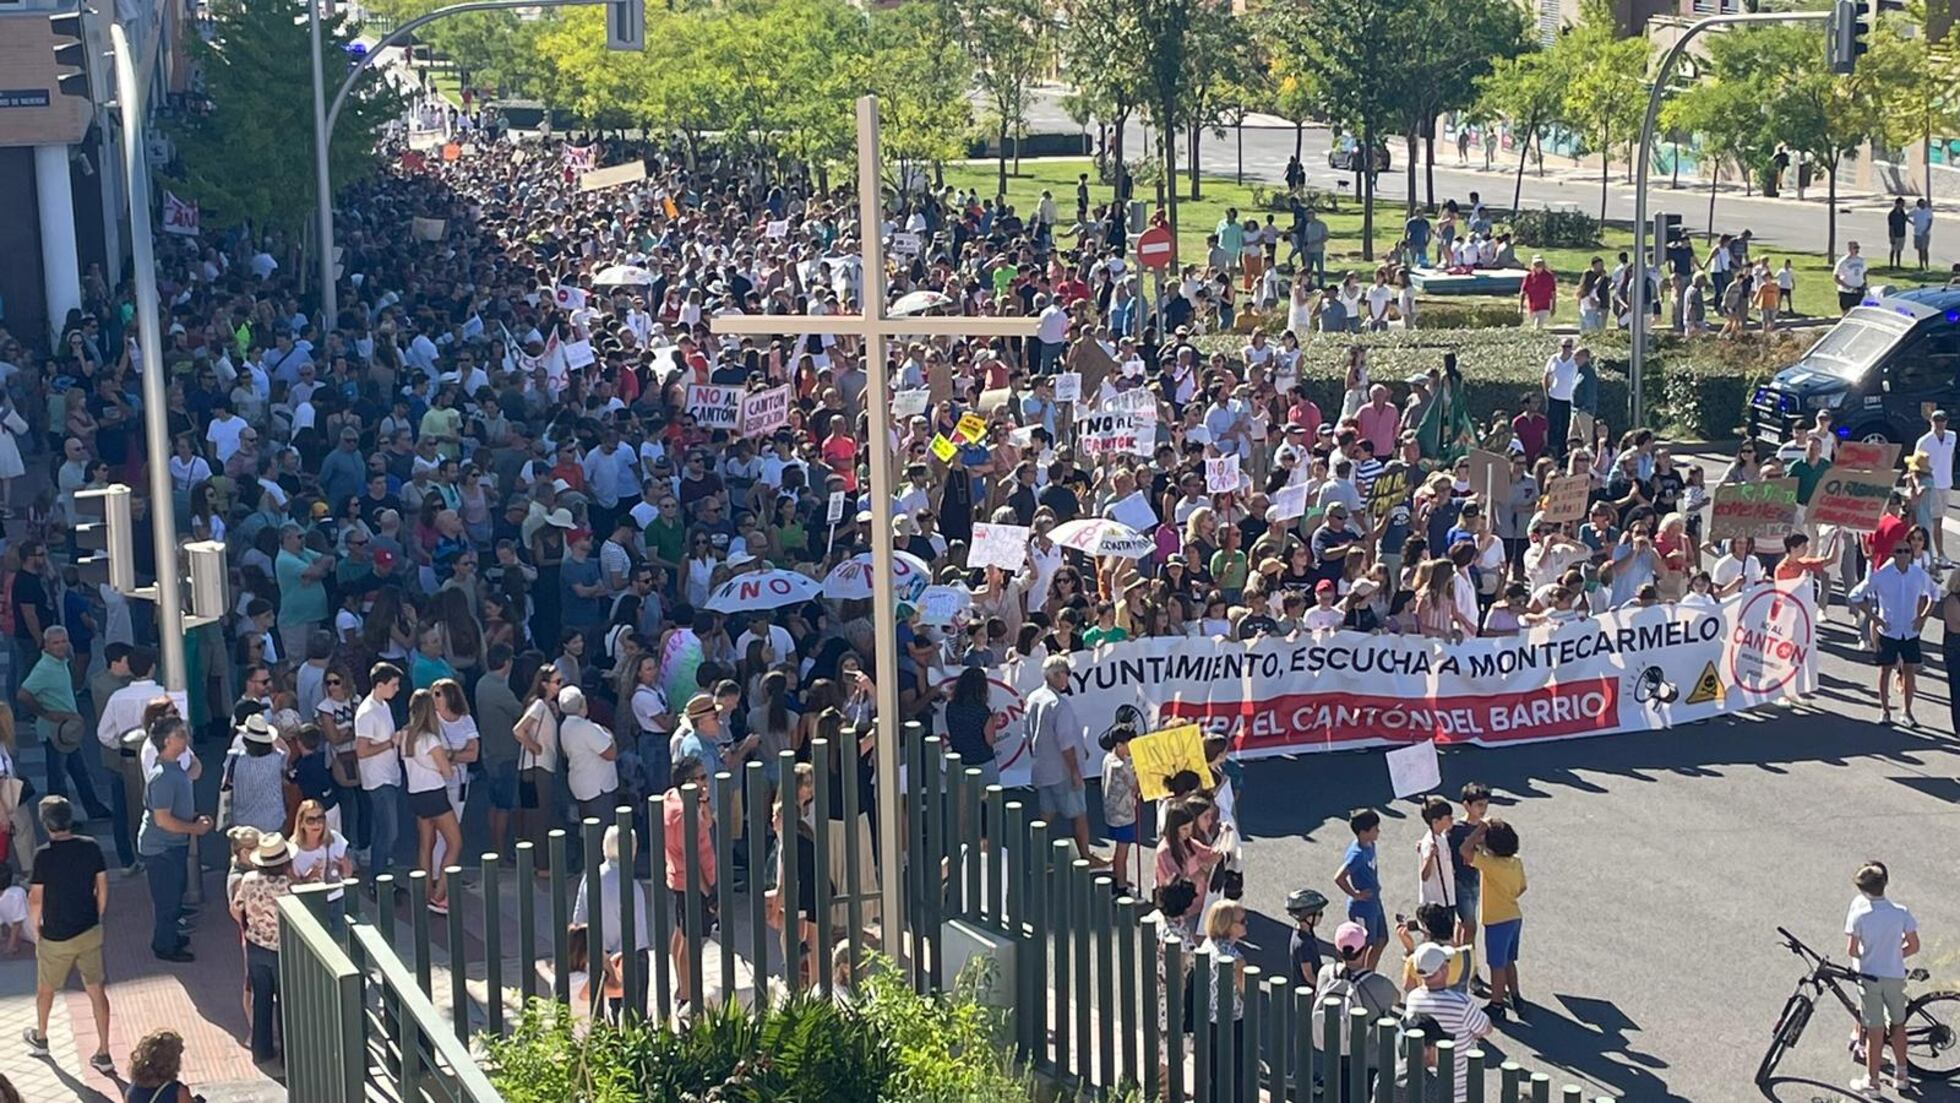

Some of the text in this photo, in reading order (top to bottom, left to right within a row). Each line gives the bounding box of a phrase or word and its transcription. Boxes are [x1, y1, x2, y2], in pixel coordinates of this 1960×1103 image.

[696, 388, 738, 406] NO AL
[1087, 416, 1112, 435] NO
[740, 578, 792, 600] NO
[1290, 647, 1431, 676] ESCUCHA
[1439, 659, 1460, 676] A
[1469, 616, 1720, 678] MONTECARMELO
[1253, 709, 1286, 736] EL
[1292, 702, 1433, 732] CANTÓN
[1434, 708, 1484, 734] DEL
[1489, 692, 1606, 732] BARRIO
